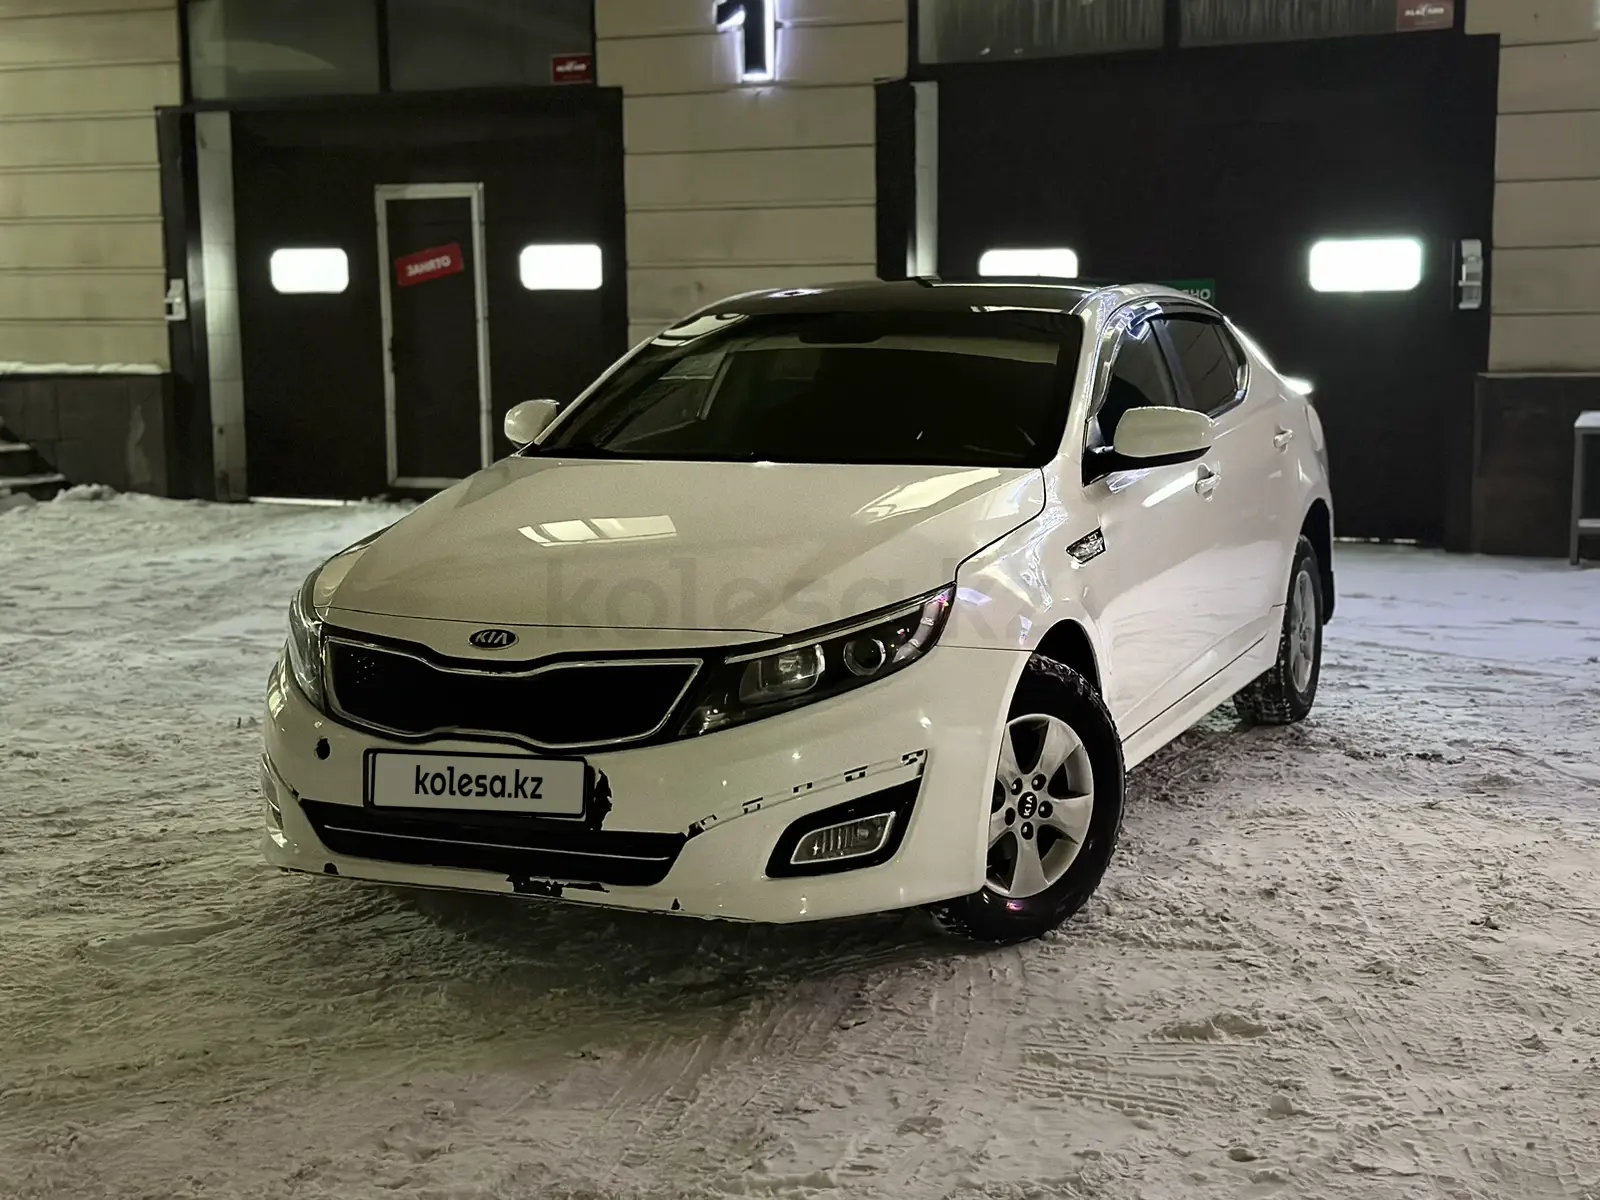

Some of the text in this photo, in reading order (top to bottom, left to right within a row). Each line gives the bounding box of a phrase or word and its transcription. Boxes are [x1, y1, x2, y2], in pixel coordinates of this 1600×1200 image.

[714, 0, 775, 81] 1
[405, 255, 452, 277] ЗАНЯТО
[474, 631, 508, 645] KIA
[1023, 795, 1034, 816] KIA
